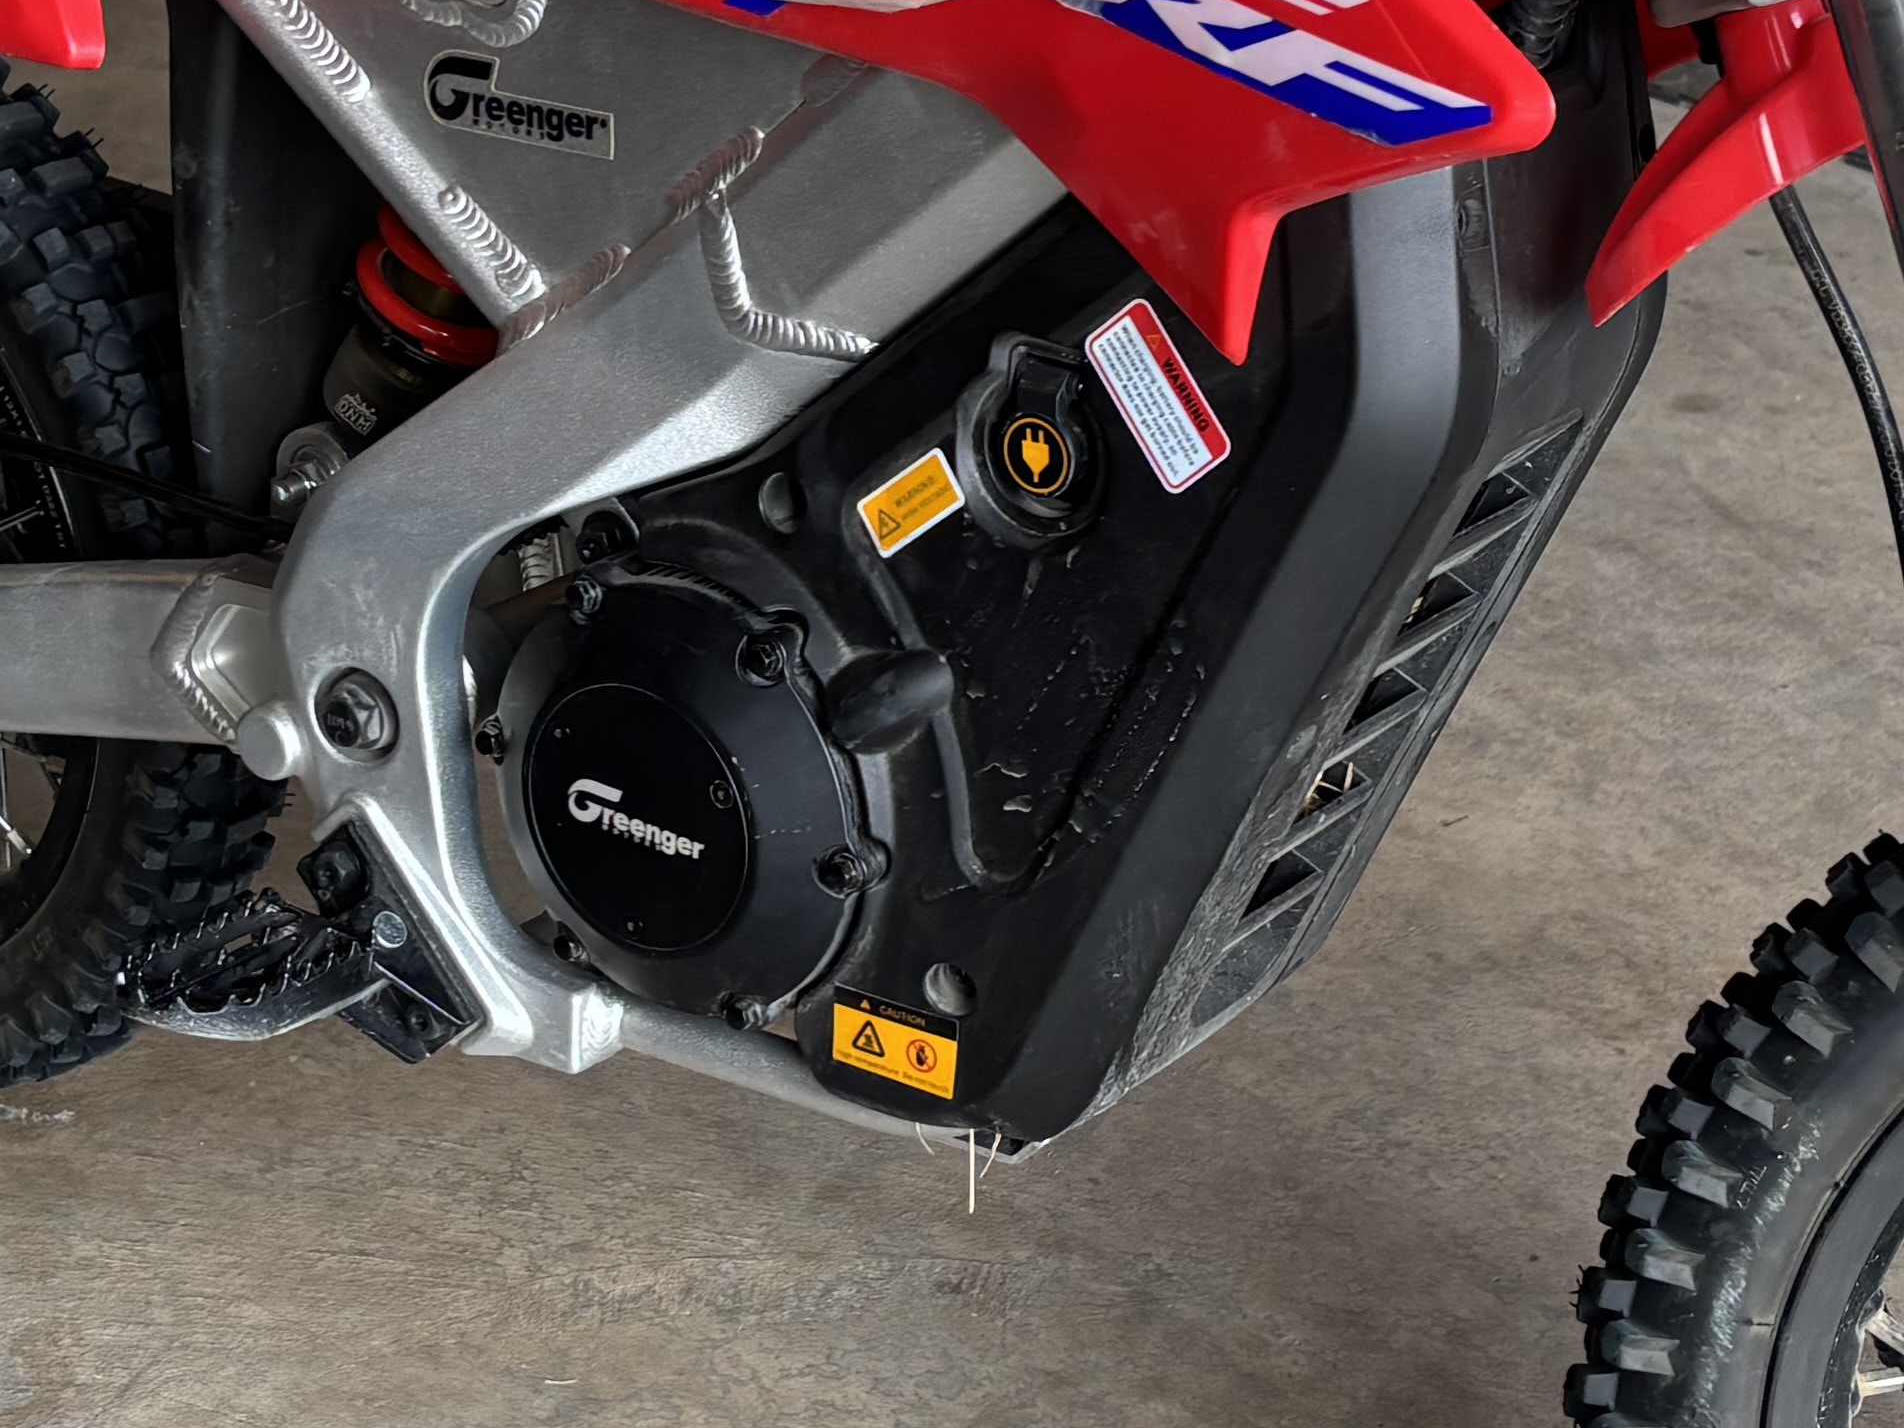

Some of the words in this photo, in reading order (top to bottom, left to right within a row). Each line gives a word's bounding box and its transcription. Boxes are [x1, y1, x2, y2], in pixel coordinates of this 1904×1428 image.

[428, 56, 599, 142] Greenger
[1118, 324, 1138, 349] When
[1173, 415, 1193, 443] should
[1135, 391, 1154, 417] power
[1141, 382, 1167, 418] charging
[1175, 438, 1196, 467] before
[1160, 358, 1211, 433] WARNING
[567, 778, 706, 860] Greenger
[880, 1004, 926, 1028] CAUTION
